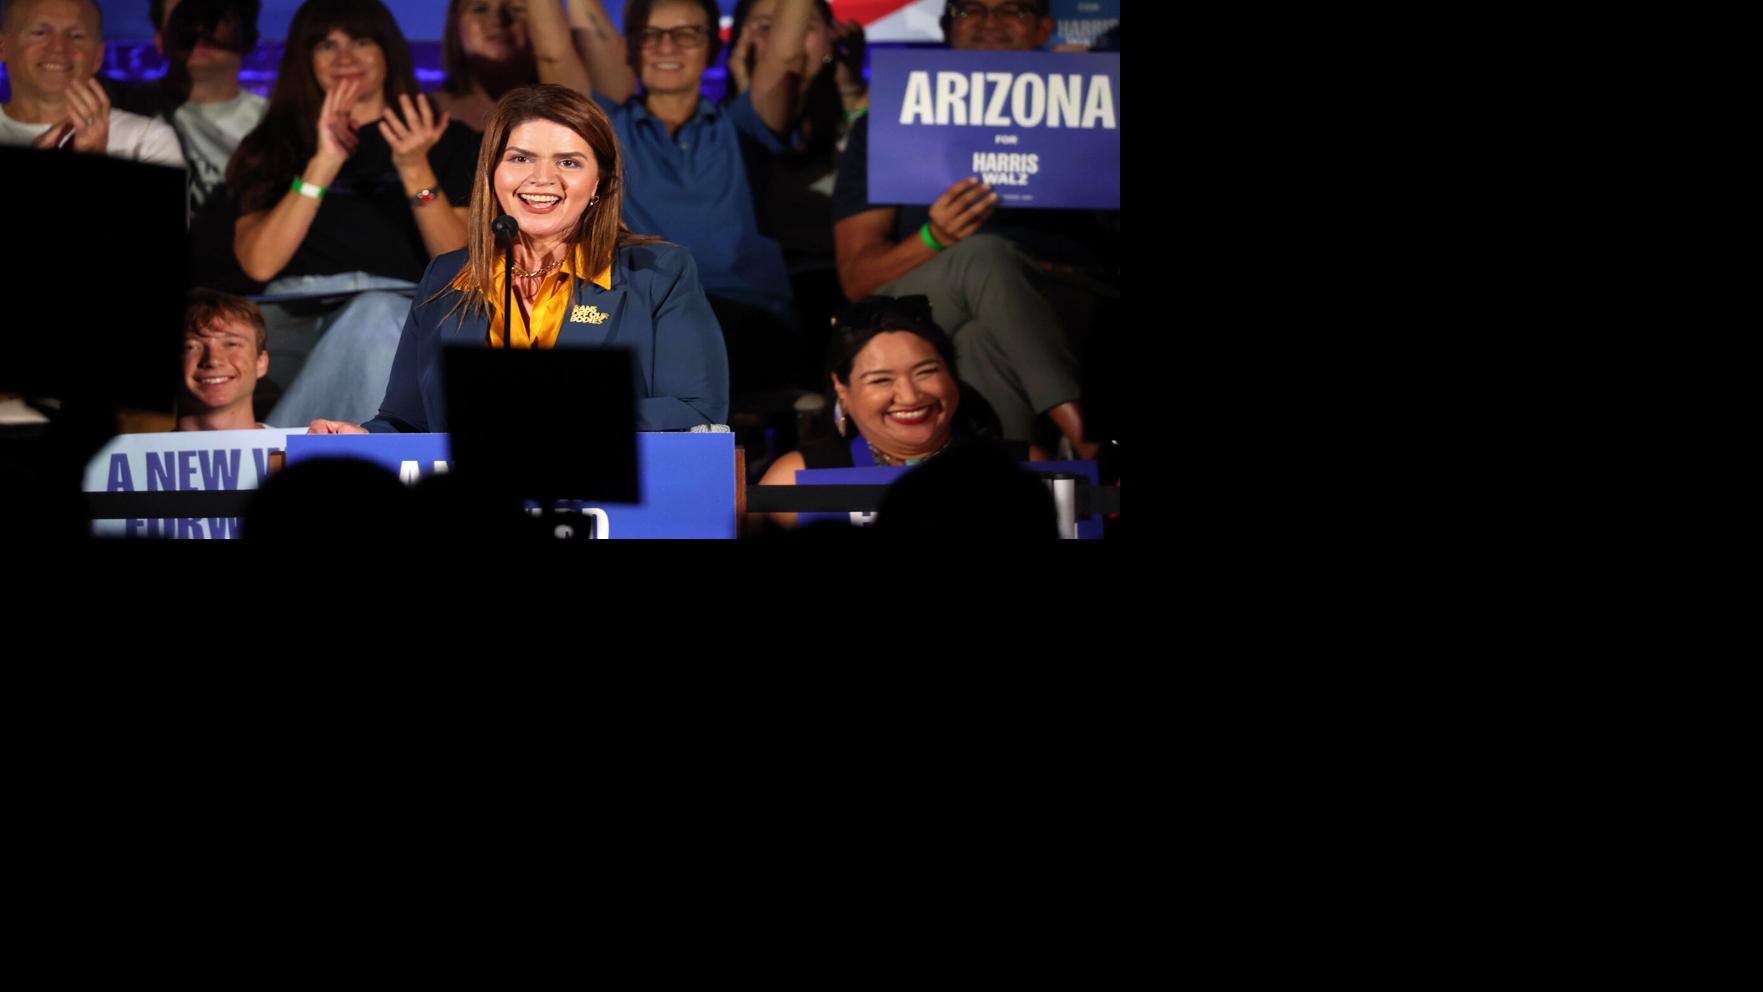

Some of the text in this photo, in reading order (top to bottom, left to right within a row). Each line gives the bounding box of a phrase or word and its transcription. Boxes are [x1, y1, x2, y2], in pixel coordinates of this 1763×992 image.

[899, 70, 1117, 129] ARIZONA
[994, 134, 1018, 145] FOR
[972, 152, 1039, 174] HARRIS
[981, 172, 1029, 186] WALZ
[106, 453, 135, 491] A
[146, 448, 241, 491] NEW
